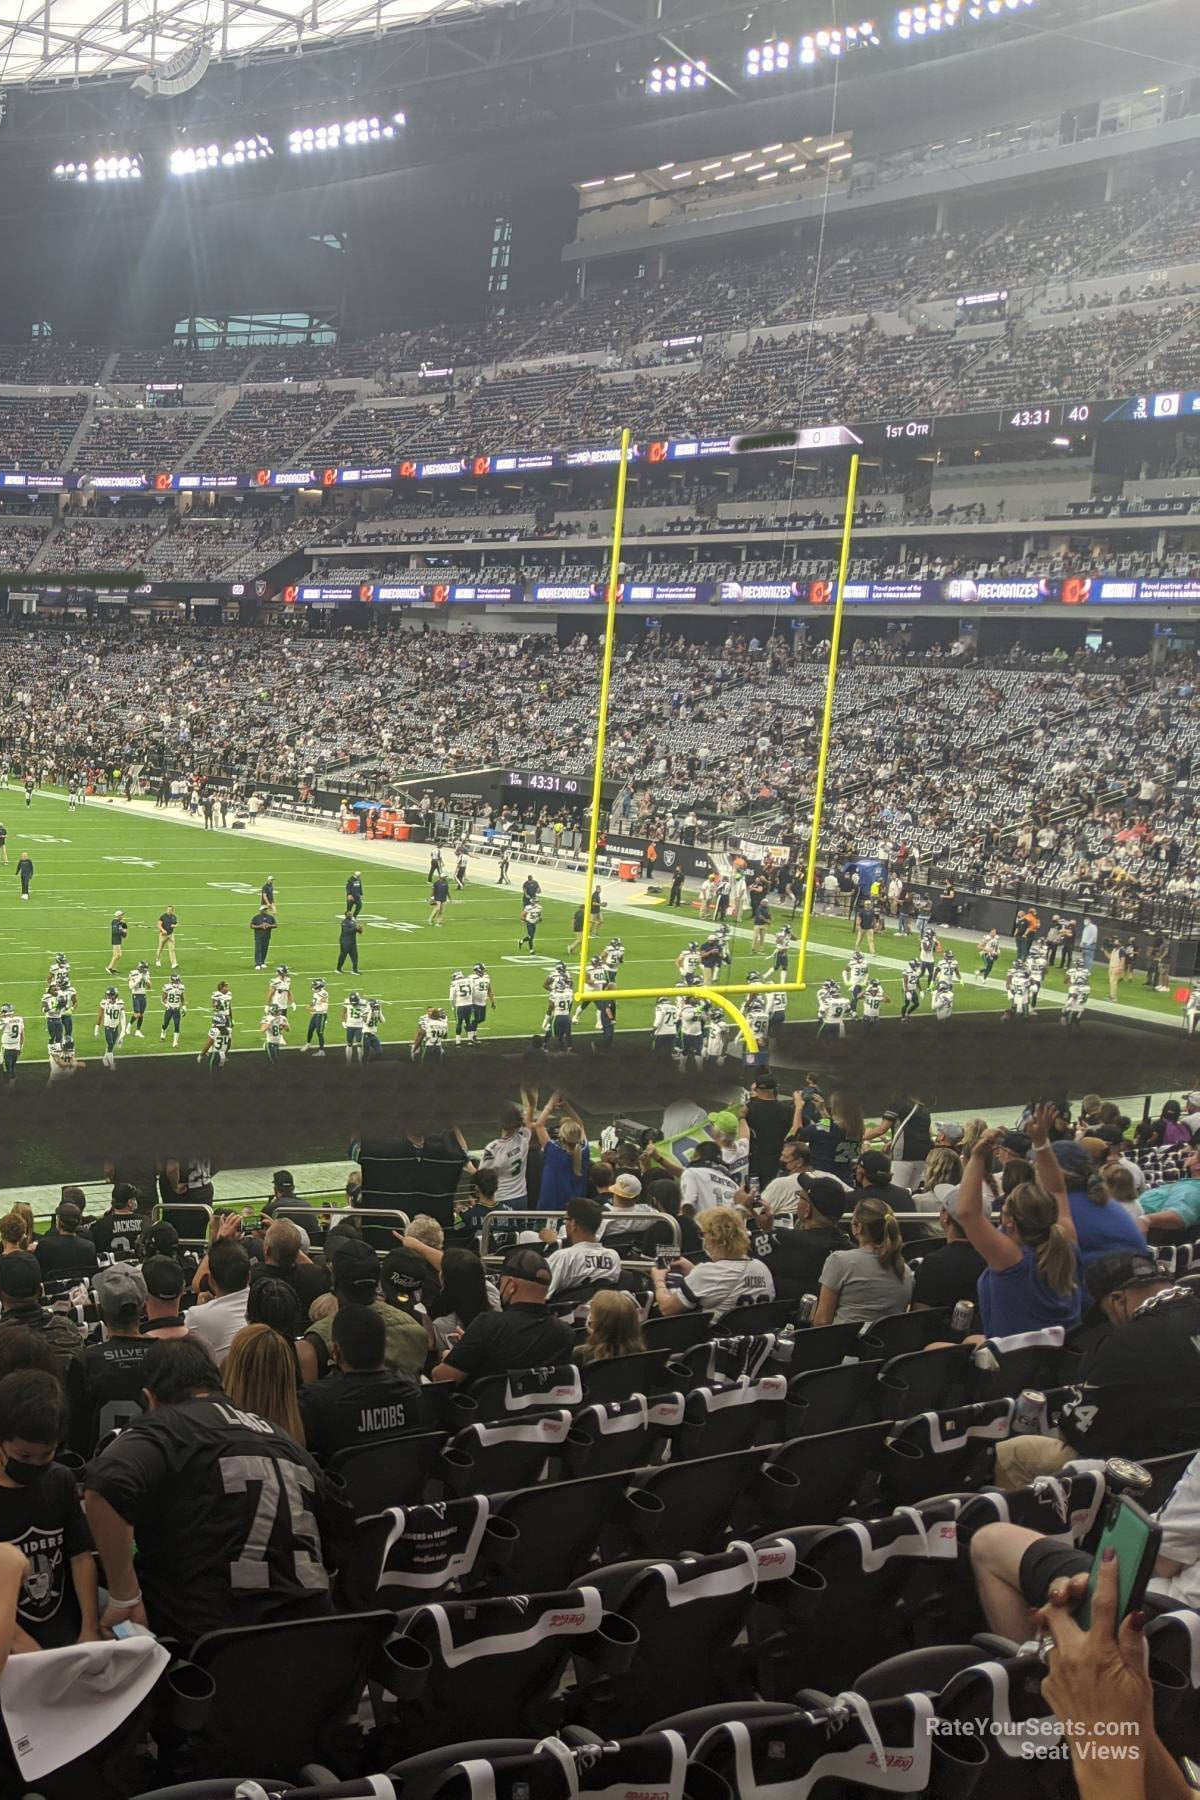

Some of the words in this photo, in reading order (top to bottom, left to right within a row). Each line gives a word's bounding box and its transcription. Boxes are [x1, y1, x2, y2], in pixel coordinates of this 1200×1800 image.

[1136, 398, 1146, 411] 3
[1161, 399, 1171, 413] 0
[1011, 410, 1050, 427] 43:31
[1068, 406, 1089, 421] 40
[886, 425, 903, 438] 1ST
[906, 422, 929, 437] QTR
[530, 776, 560, 790] 43:31
[565, 781, 578, 791] 40
[620, 847, 644, 857] RAIDERS
[866, 999, 880, 1010] 48
[105, 1008, 119, 1020] 40
[11, 1024, 19, 1038] 9
[754, 1234, 772, 1257] 28
[358, 1403, 406, 1433] JACOBS
[218, 1455, 330, 1590] 75
